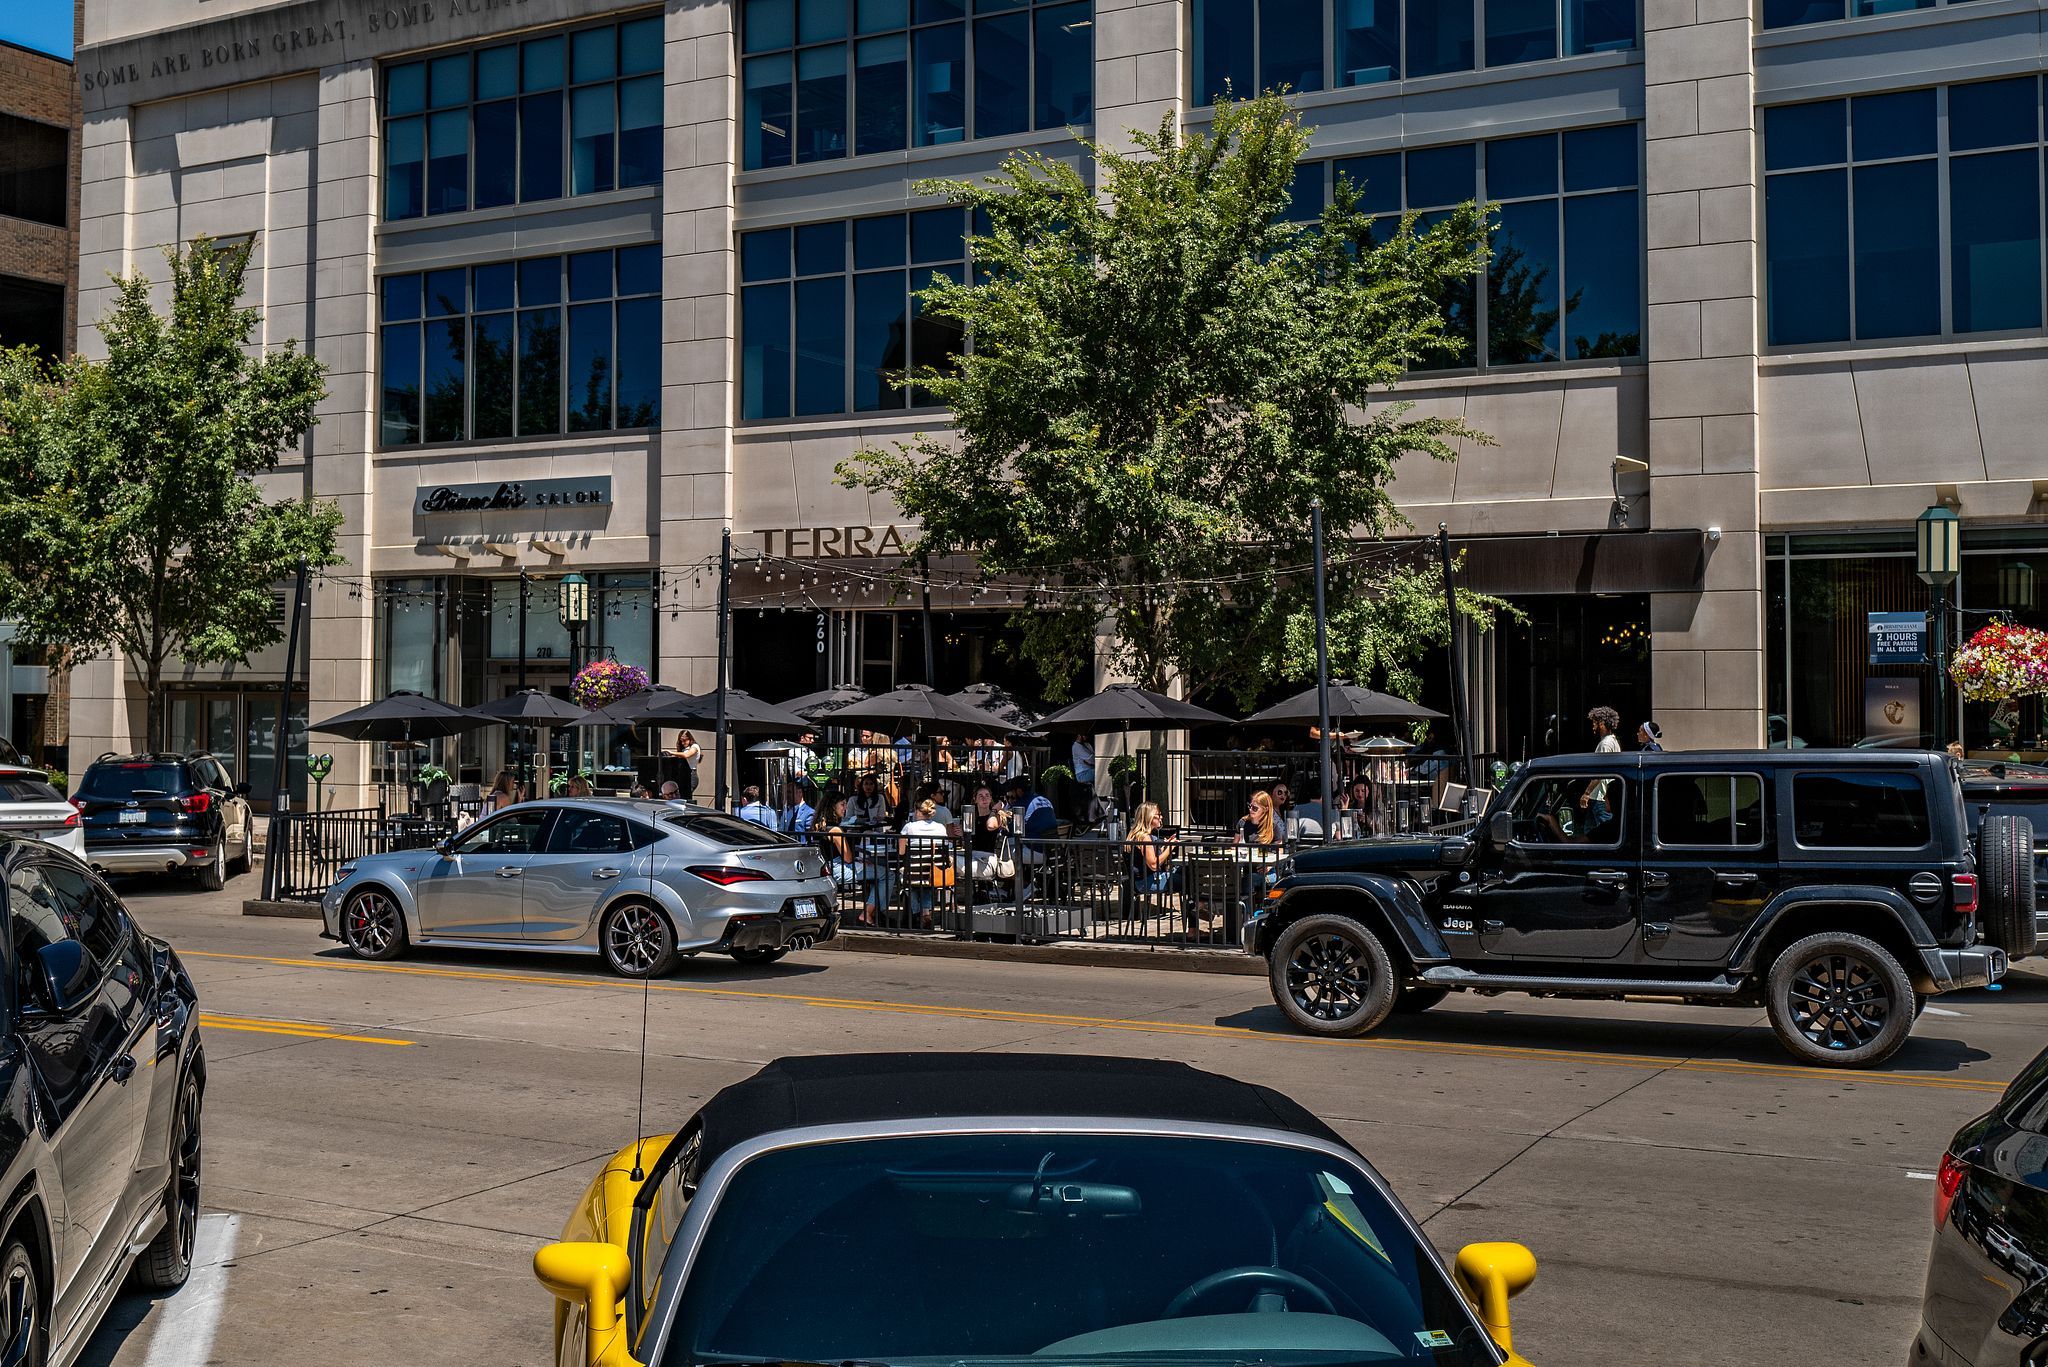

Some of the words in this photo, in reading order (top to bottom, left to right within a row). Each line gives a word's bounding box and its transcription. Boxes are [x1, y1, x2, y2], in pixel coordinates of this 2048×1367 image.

[84, 63, 139, 92] SOME
[150, 54, 191, 79] ARE
[202, 39, 261, 68] BORN
[272, 20, 356, 53] GREAT,
[367, 2, 435, 34] SOME
[535, 490, 603, 506] SALON
[752, 525, 914, 559] TERRA
[816, 613, 825, 653] 260
[1877, 633, 1883, 641] 2
[1886, 633, 1918, 641] HOURS
[536, 647, 552, 658] 270
[1443, 917, 1473, 931] Jeep
